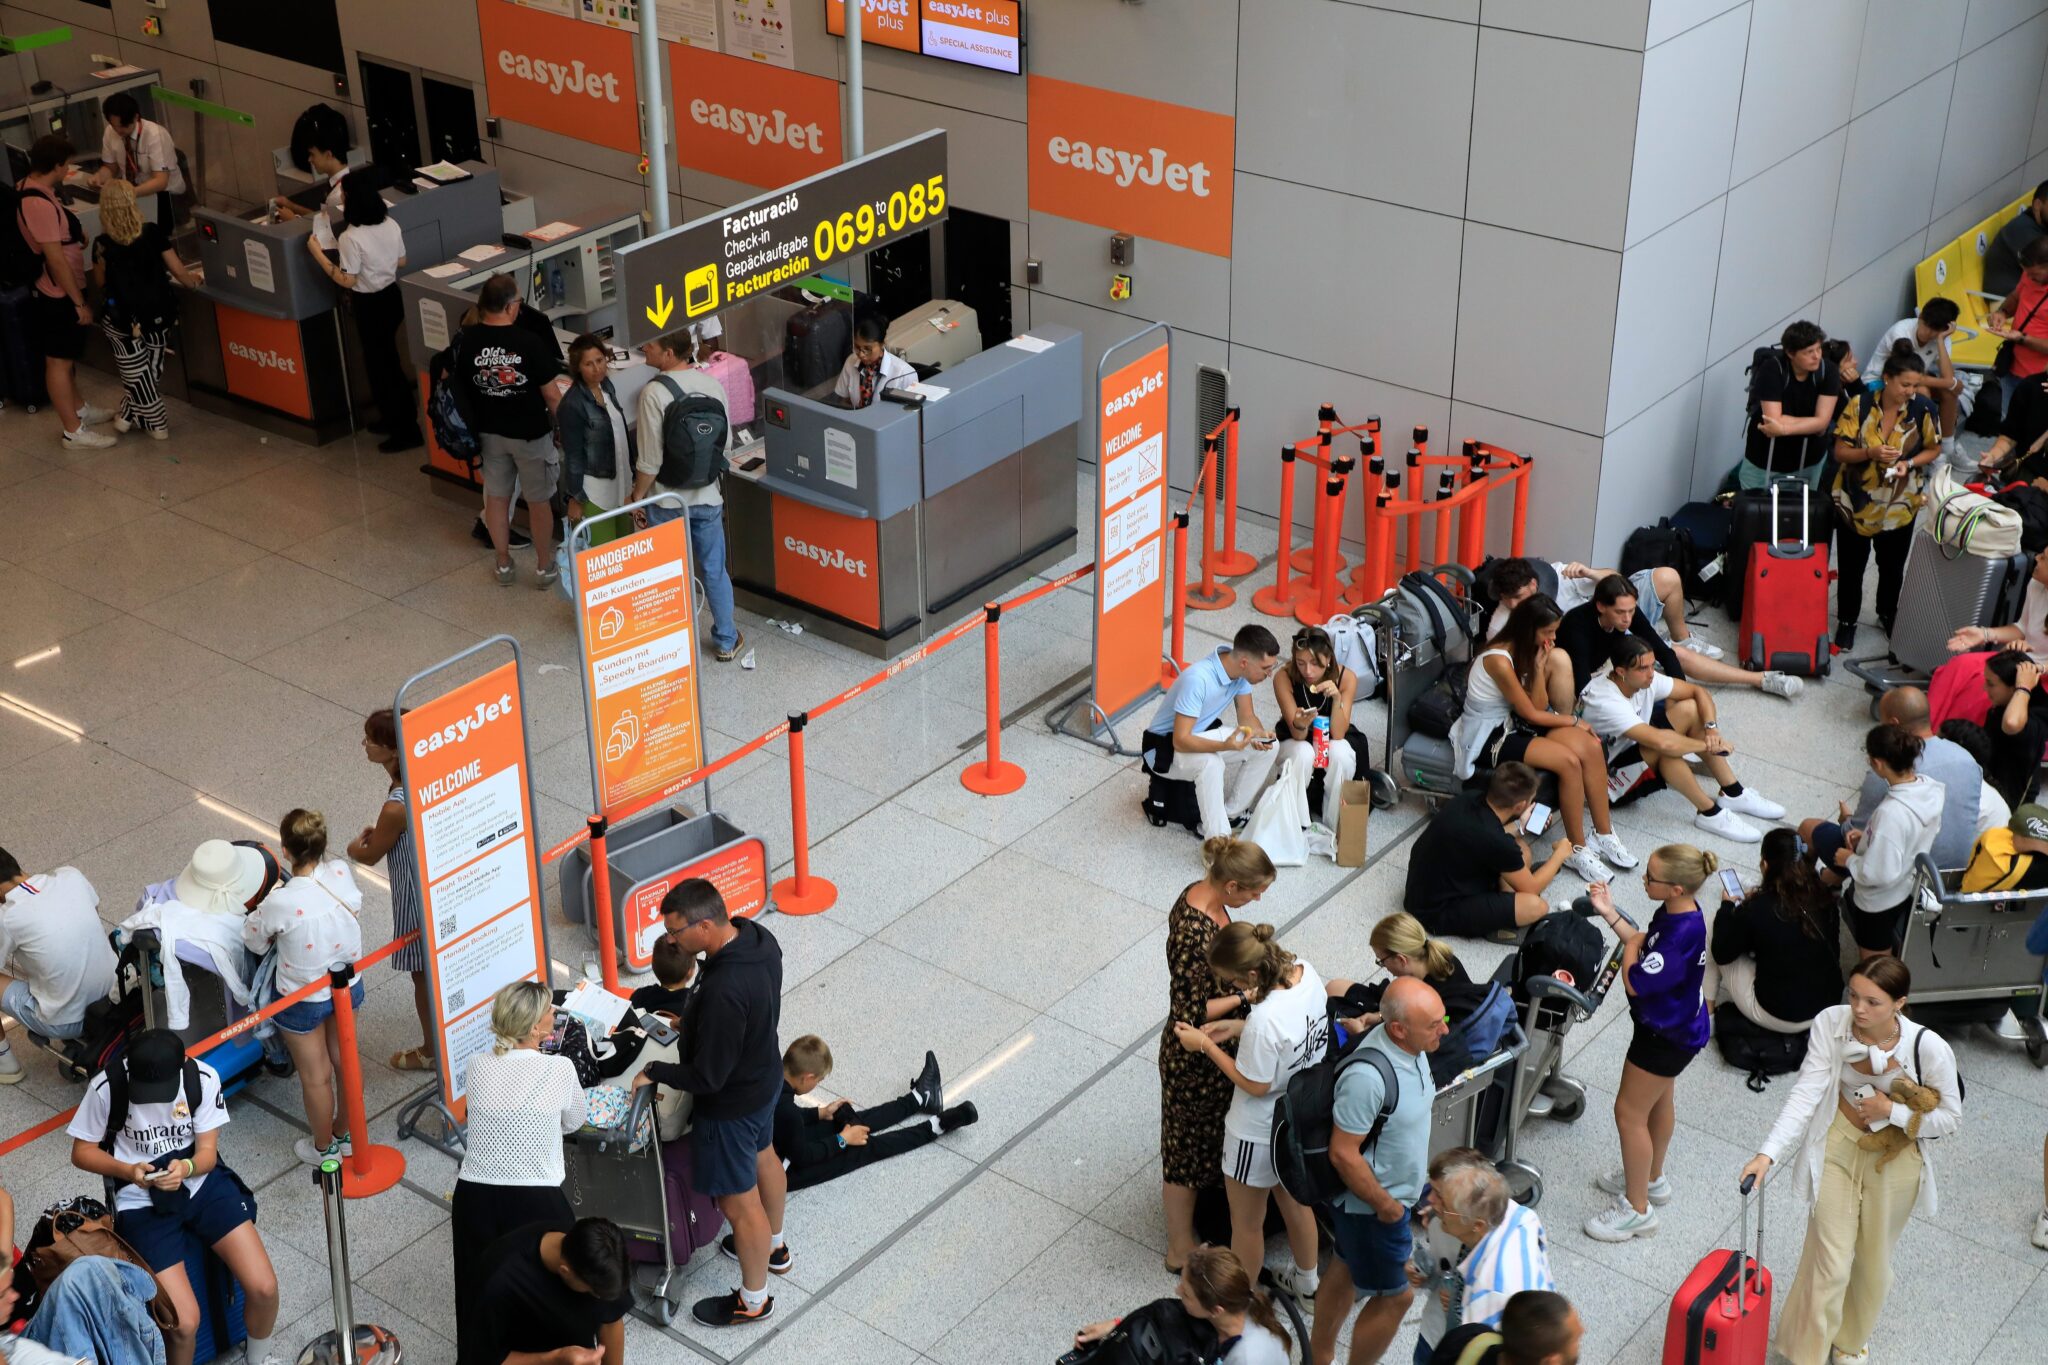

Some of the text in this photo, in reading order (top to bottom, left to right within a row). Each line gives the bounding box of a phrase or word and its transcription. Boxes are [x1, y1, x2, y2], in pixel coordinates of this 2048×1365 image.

[878, 14, 904, 31] plus
[929, 1, 1010, 26] easyJet plus
[939, 36, 1012, 59] SPECIAL ASSISTANCE
[498, 49, 620, 103] easyJet
[690, 98, 823, 154] easyJet
[1048, 135, 1211, 197] easyJet
[723, 192, 799, 238] Facturació
[814, 174, 945, 262] 069 to a 085
[724, 228, 770, 258] Check-in
[726, 235, 808, 279] Gepäckaufgabe
[727, 254, 809, 302] Facturación
[229, 341, 296, 374] easyJet
[481, 347, 501, 358] Old
[1105, 370, 1164, 417] easyJet
[1105, 422, 1143, 456] WELCOME
[586, 537, 654, 573] HANDGEPÄCK
[784, 535, 868, 578] easyJet
[588, 563, 623, 583] CABIN BAGS
[1053, 572, 1077, 587] easyJet
[591, 588, 608, 602] Alle
[610, 575, 644, 595] Kunden
[597, 647, 649, 673] Kunden mit
[886, 651, 922, 678] FLIGHT TRACKER
[843, 686, 861, 699] easyJet
[413, 693, 513, 758] easyJet
[418, 758, 482, 806] WELCOME
[663, 777, 692, 796] easyJet
[428, 795, 466, 821] Mobile App
[436, 865, 480, 896] Flight Tracker
[640, 888, 665, 902] MAXIMUM
[731, 899, 759, 917] easyJet
[443, 925, 497, 962] Manage Booking
[220, 1013, 260, 1040] easyJet
[451, 1016, 475, 1035] easyJet
[123, 1122, 192, 1141] Emirates
[135, 1136, 183, 1155] FLY BETTER
